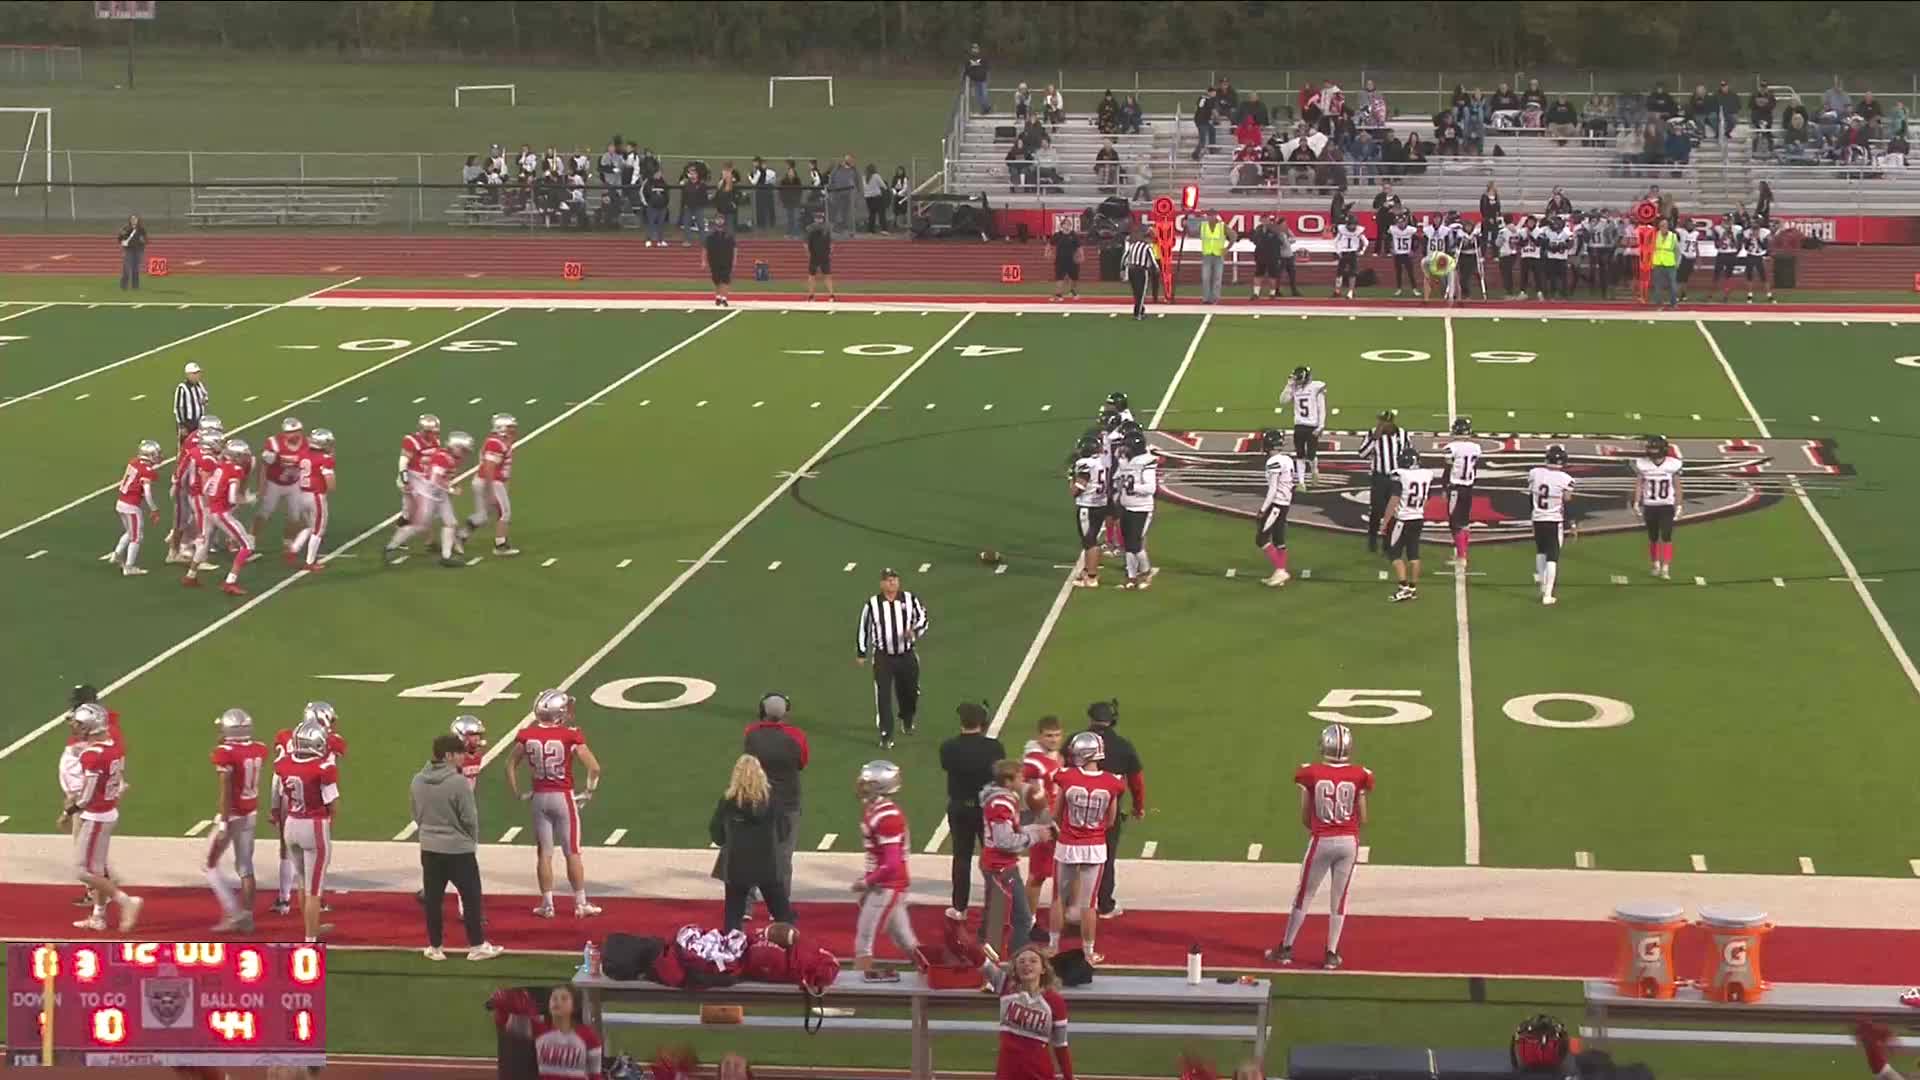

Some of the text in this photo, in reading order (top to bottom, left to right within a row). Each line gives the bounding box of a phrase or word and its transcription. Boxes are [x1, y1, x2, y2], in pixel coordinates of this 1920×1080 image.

[1299, 398, 1309, 418] 5
[1407, 481, 1427, 508] 21
[1538, 484, 1550, 510] 2
[525, 739, 566, 781] 32
[1638, 937, 1660, 961] G
[1724, 940, 1747, 966] G
